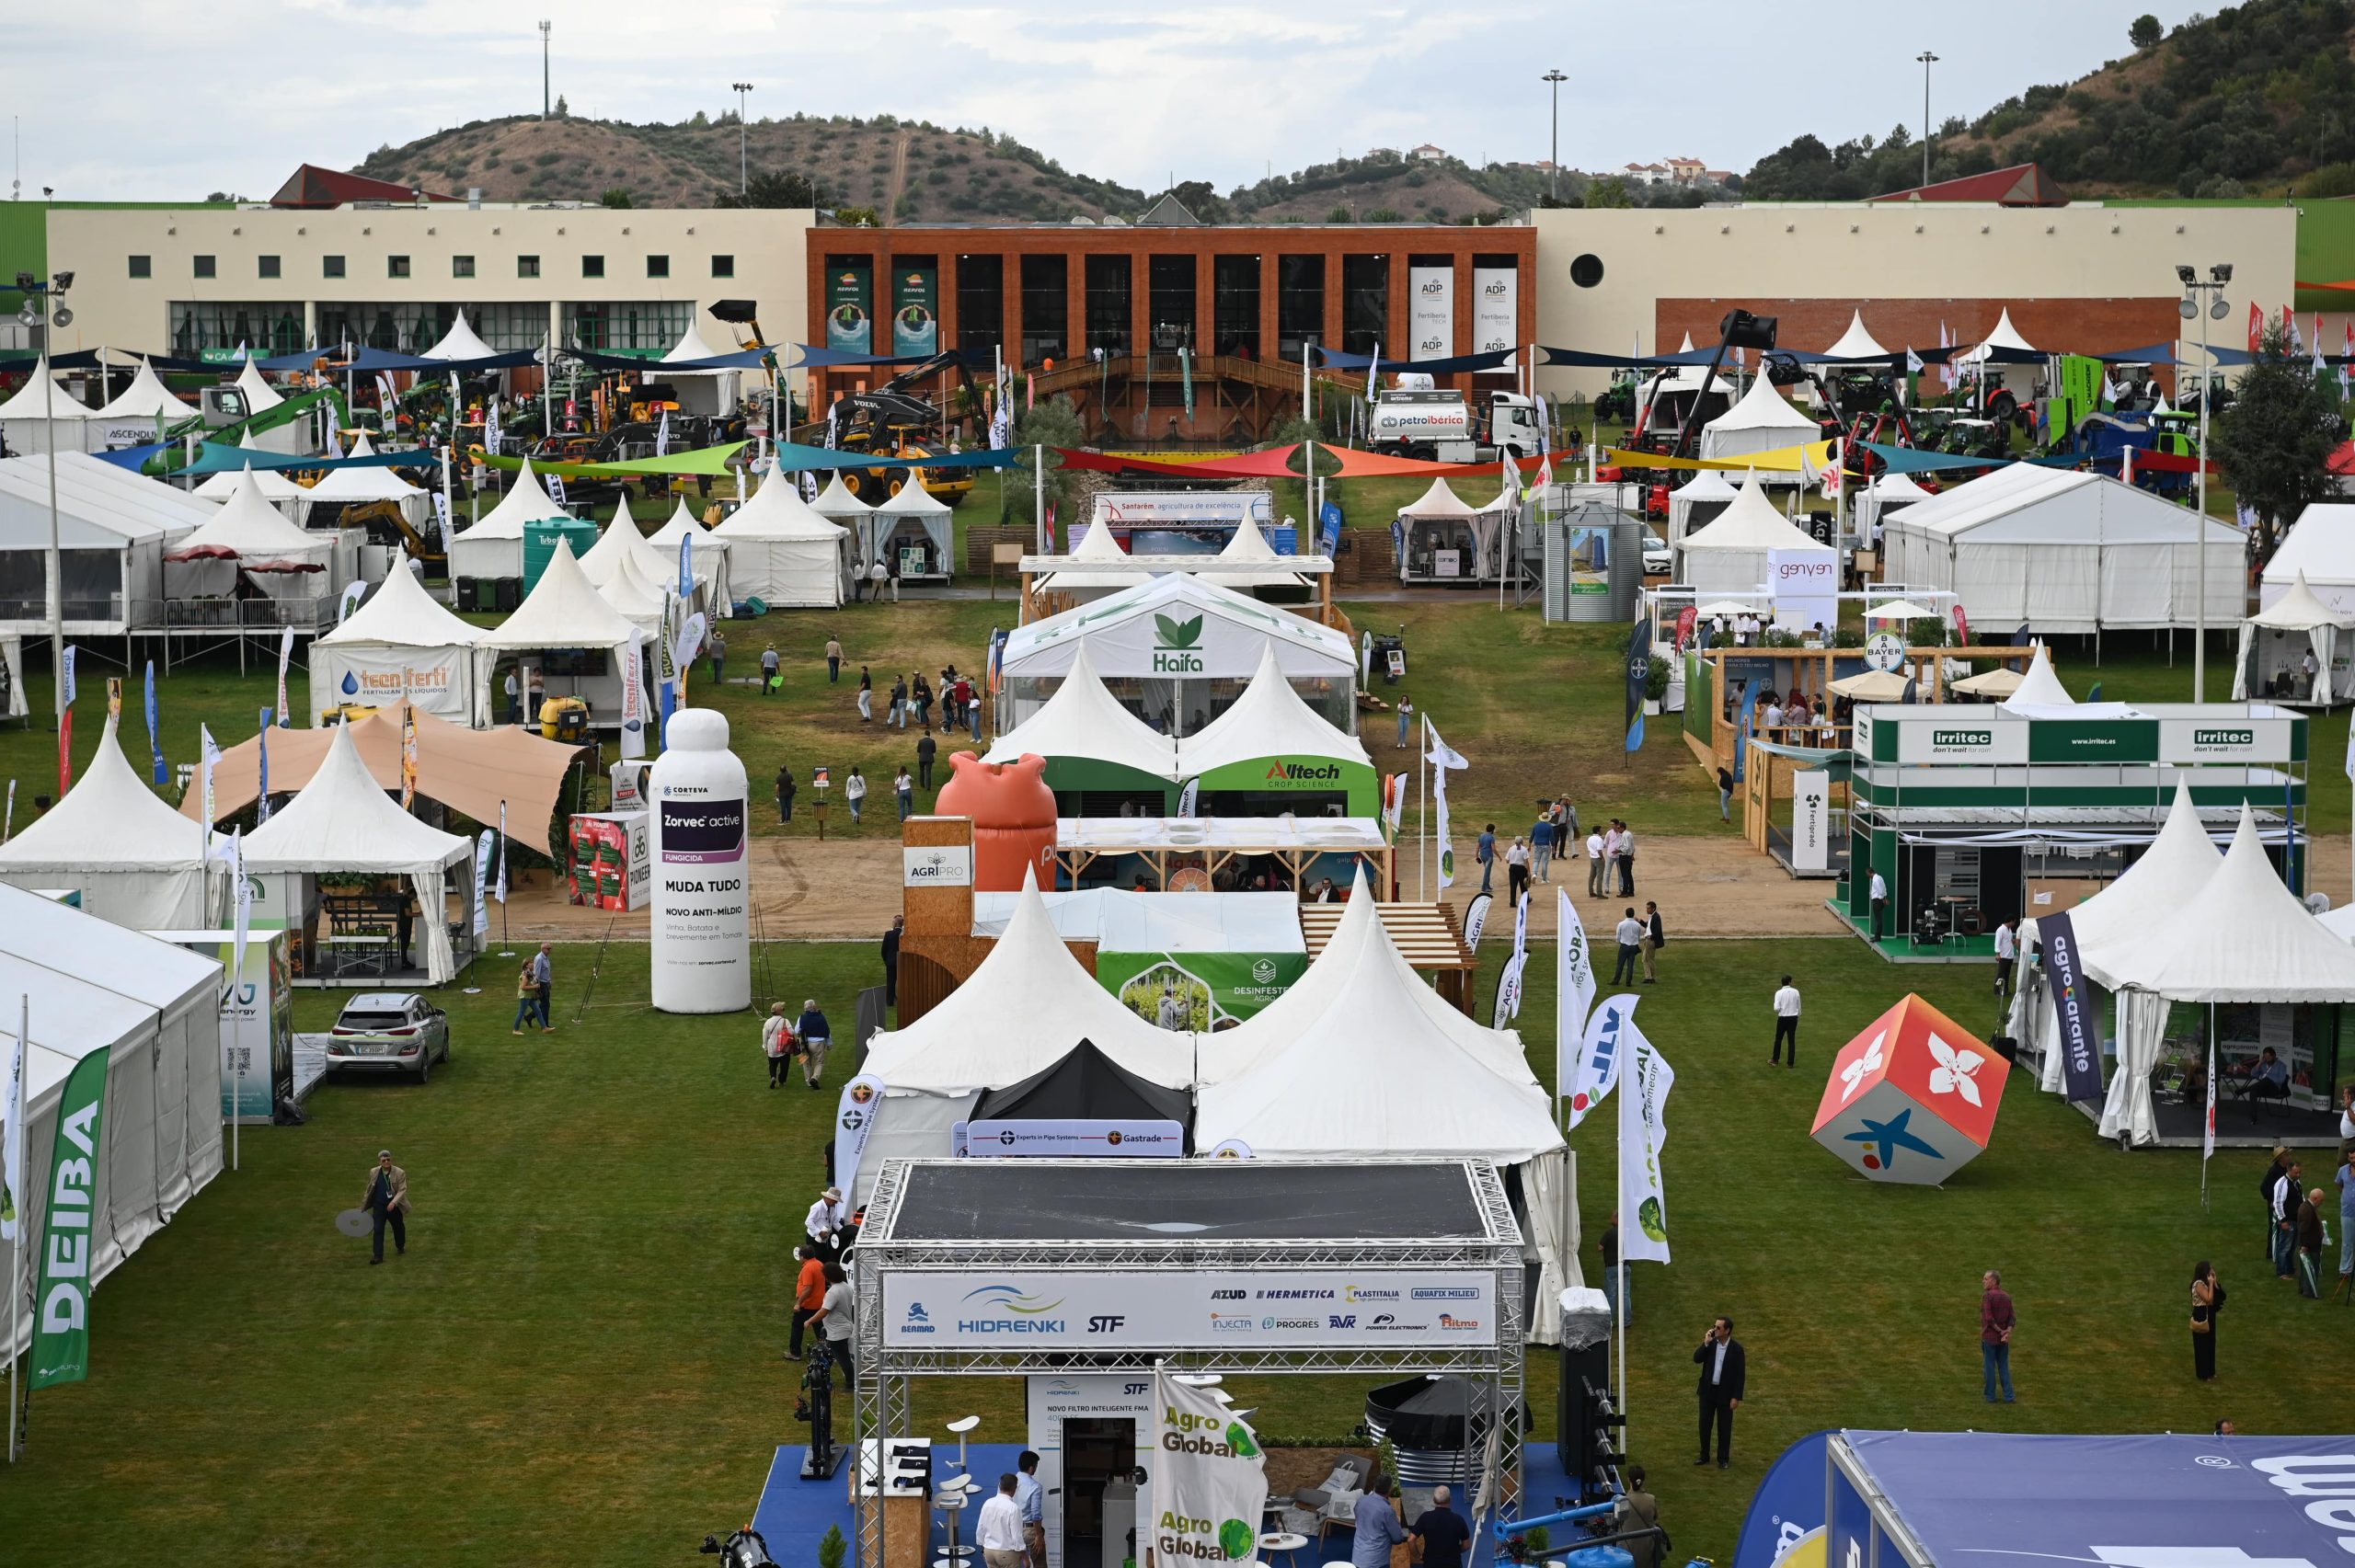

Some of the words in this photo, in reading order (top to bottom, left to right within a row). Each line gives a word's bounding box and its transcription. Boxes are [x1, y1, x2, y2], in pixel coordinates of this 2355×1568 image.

[1421, 284, 1442, 293] ADP
[1485, 285, 1506, 294] ADP
[1421, 341, 1442, 350] ADP
[1485, 343, 1506, 351] ADP
[1399, 415, 1464, 428] petroibérica
[1157, 502, 1194, 511] agricultura
[1153, 653, 1203, 672] Haifa
[361, 667, 447, 687] tecnferti
[1936, 732, 1990, 744] irritec
[2197, 731, 2251, 743] irritec
[1266, 759, 1340, 780] Alltech
[708, 814, 741, 828] active
[665, 853, 704, 863] FUNGICIDA
[911, 864, 964, 877] AGRIPRO
[665, 880, 705, 893] MUDA
[707, 878, 741, 893] TUDO
[665, 908, 691, 917] NOVO
[692, 905, 742, 917] ANTI-MÍLDIO
[1254, 994, 1276, 1002] AGRO
[2053, 934, 2089, 1074] agrogarante
[221, 1008, 257, 1016] enrgy
[1016, 1134, 1036, 1142] Experts
[1043, 1134, 1055, 1142] Pipe
[1056, 1134, 1079, 1142] Systems
[1123, 1133, 1162, 1143] Gastrade
[41, 1100, 98, 1334] DEIBA
[1211, 1289, 1247, 1299] AZUD
[1266, 1289, 1335, 1299] HERMETICA
[1414, 1289, 1446, 1298] AQUAFIX
[1448, 1289, 1476, 1298] MILIEU
[958, 1320, 1065, 1333] HIDRENKI
[1087, 1315, 1125, 1333] STF
[1212, 1320, 1252, 1329] INJECTA
[1328, 1314, 1357, 1329] AVK
[1442, 1314, 1478, 1327] Ritmo
[901, 1324, 936, 1333] BERMAD
[1123, 1383, 1149, 1395] STF
[1164, 1405, 1221, 1433] Agro
[1162, 1431, 1238, 1459] Global
[1159, 1511, 1212, 1535] Agro
[1159, 1536, 1229, 1562] Global
